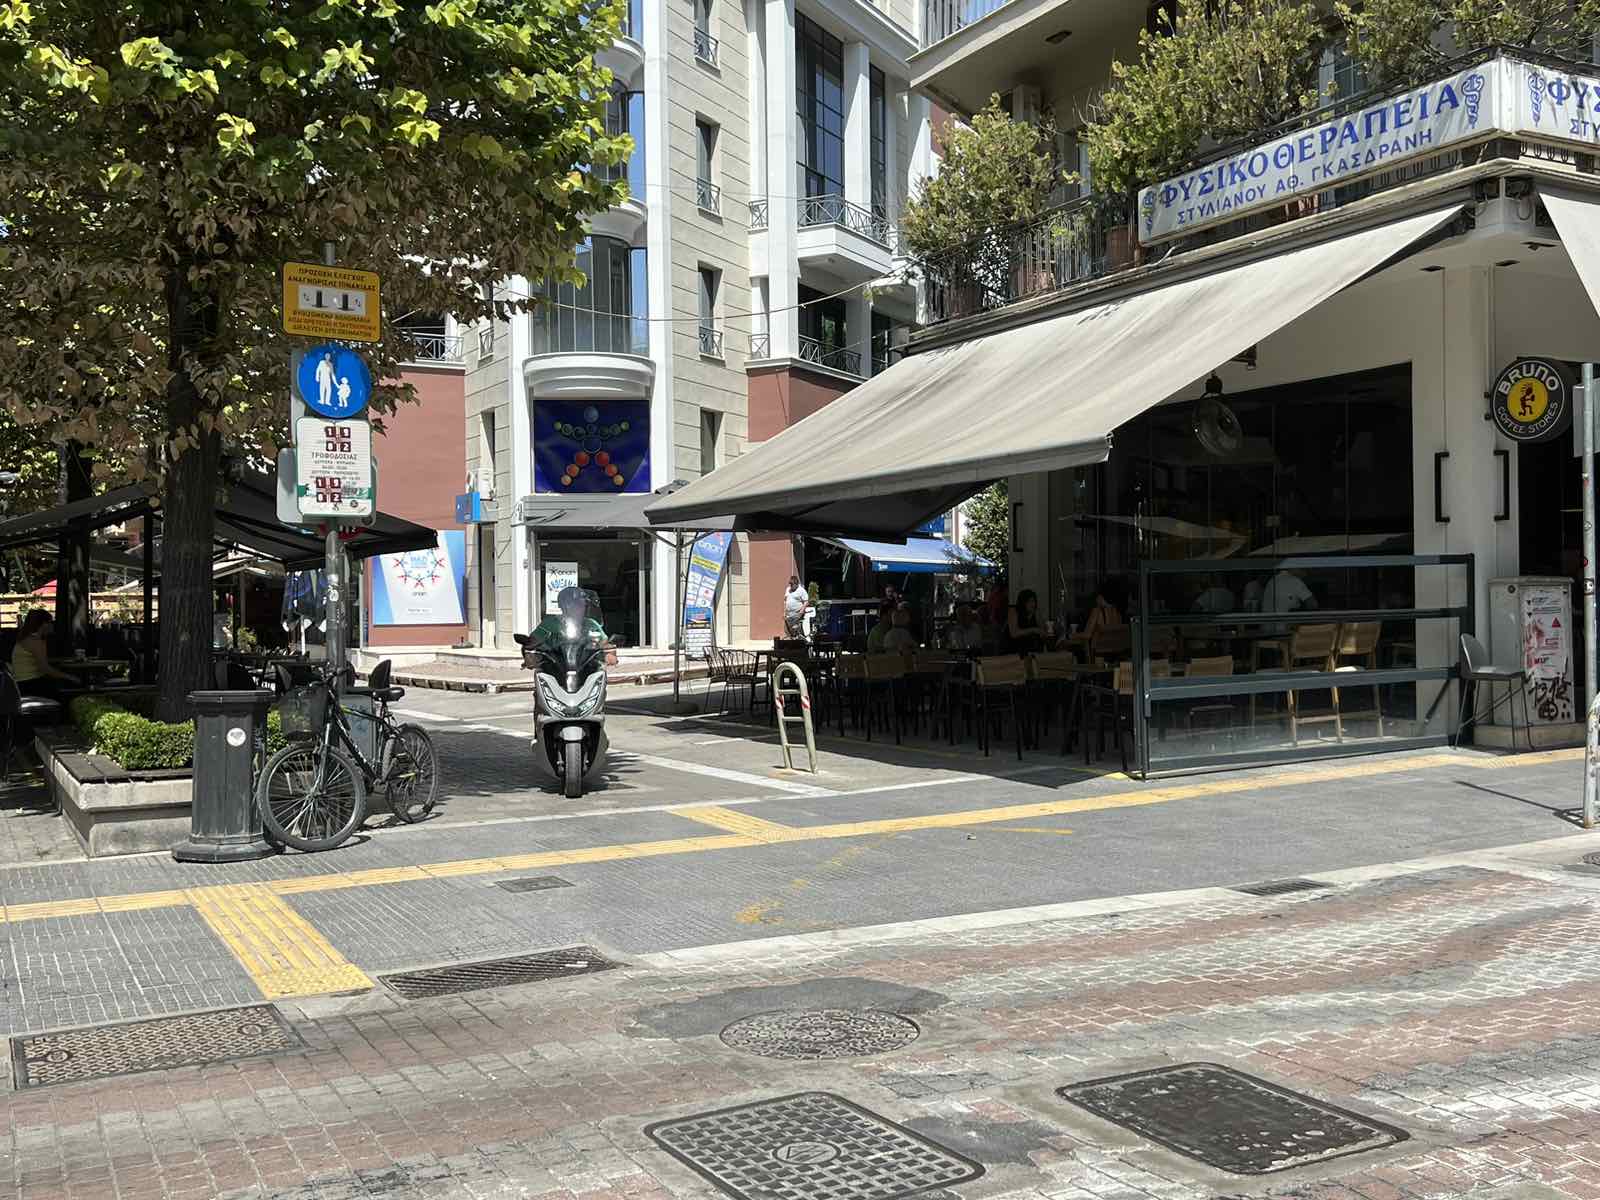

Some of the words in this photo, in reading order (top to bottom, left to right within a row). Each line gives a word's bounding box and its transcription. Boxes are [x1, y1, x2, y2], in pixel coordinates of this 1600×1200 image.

[1159, 84, 1460, 209] ΦΥΣΙΚΟΘΕΡΑΠΕΙΑ
[1177, 178, 1266, 225] ΣΤΥΛΙΑΝΟΥ
[1275, 171, 1304, 194] ΑΘ.
[1312, 127, 1433, 182] ΓΚΑΣΔΡΑΝΗ
[1528, 402, 1558, 433] STORES
